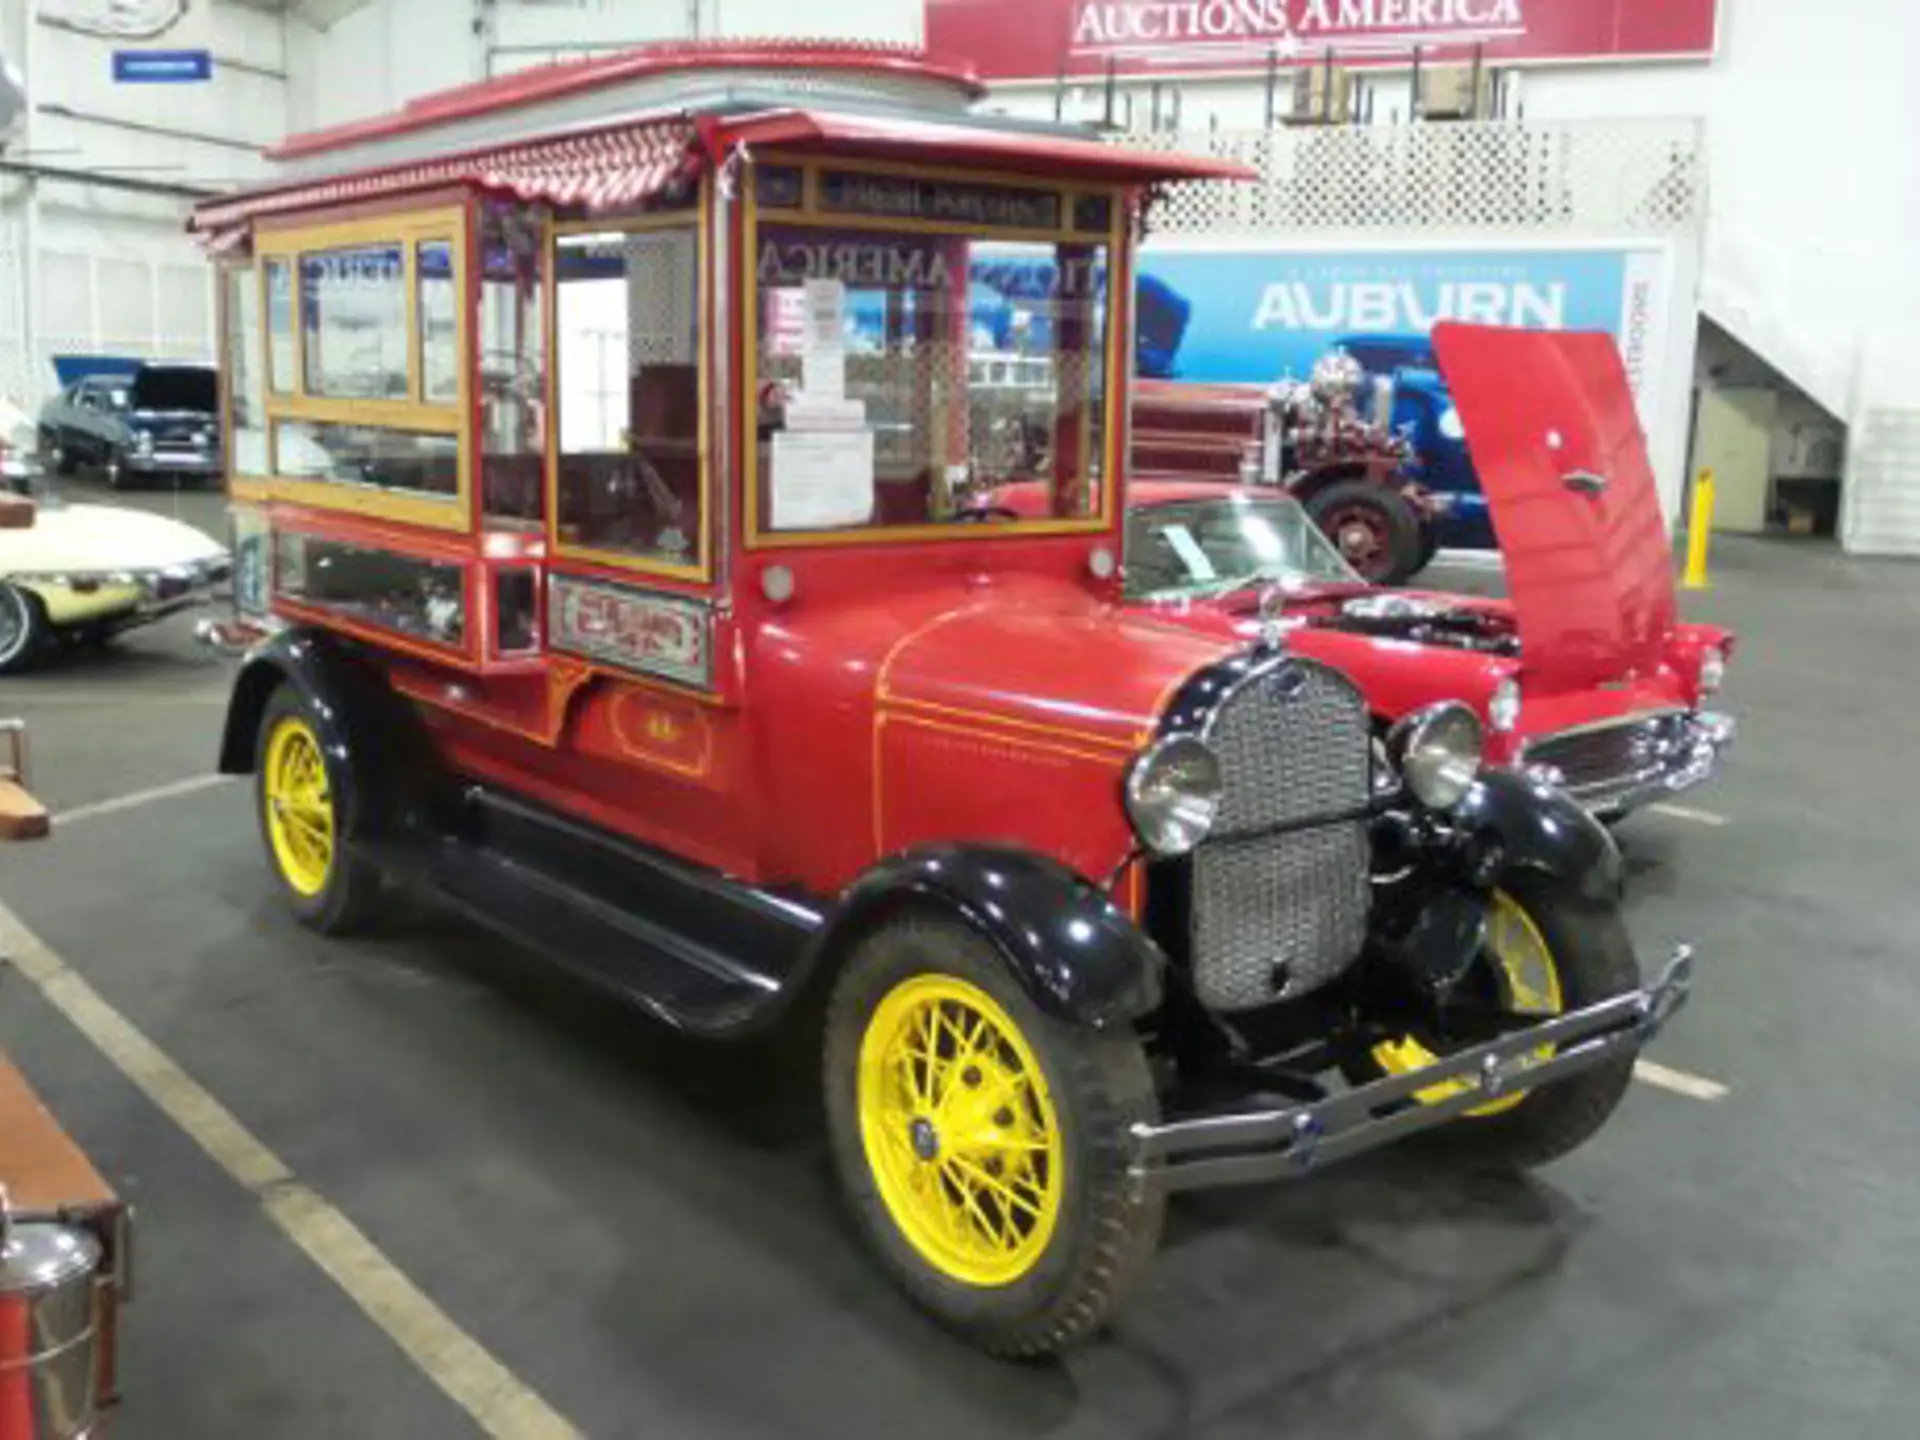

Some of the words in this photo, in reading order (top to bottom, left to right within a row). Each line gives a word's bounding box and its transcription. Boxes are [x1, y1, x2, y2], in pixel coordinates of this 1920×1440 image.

[1074, 0, 1289, 42] AUCTIONS
[1296, 0, 1524, 31] AMERICA
[1252, 281, 1566, 332] AUBURN
